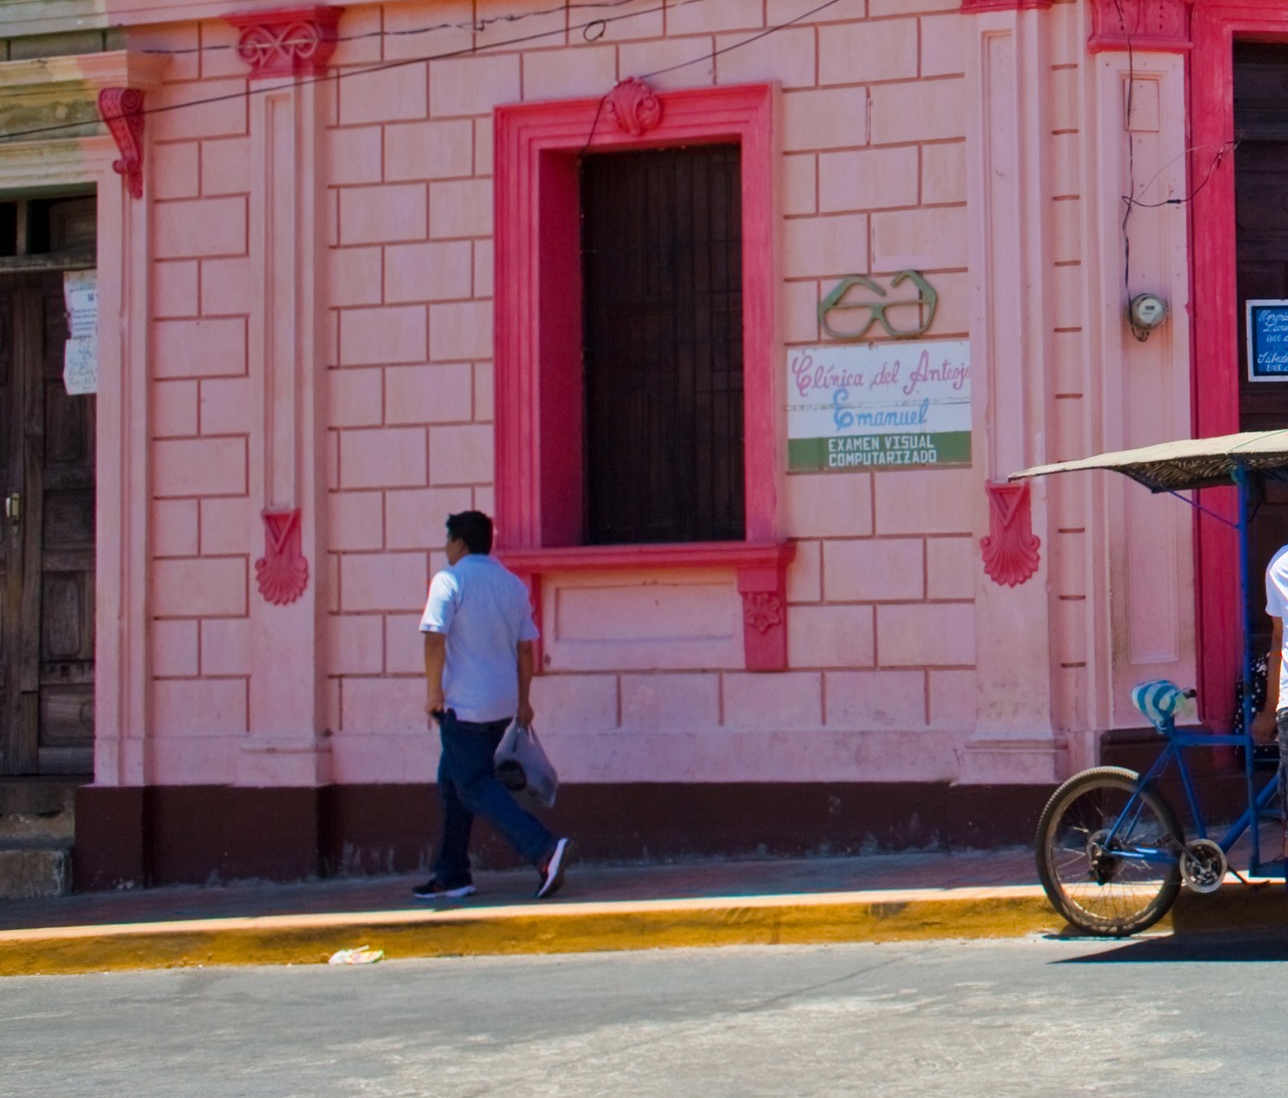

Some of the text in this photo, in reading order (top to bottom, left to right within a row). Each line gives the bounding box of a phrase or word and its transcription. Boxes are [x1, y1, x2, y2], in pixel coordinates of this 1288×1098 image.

[792, 354, 864, 397] Clínica
[870, 359, 900, 390] del
[833, 388, 930, 432] Emanuel
[828, 435, 935, 452] EXAMEN VISUAL
[828, 449, 937, 468] COMPUTARIZADO
